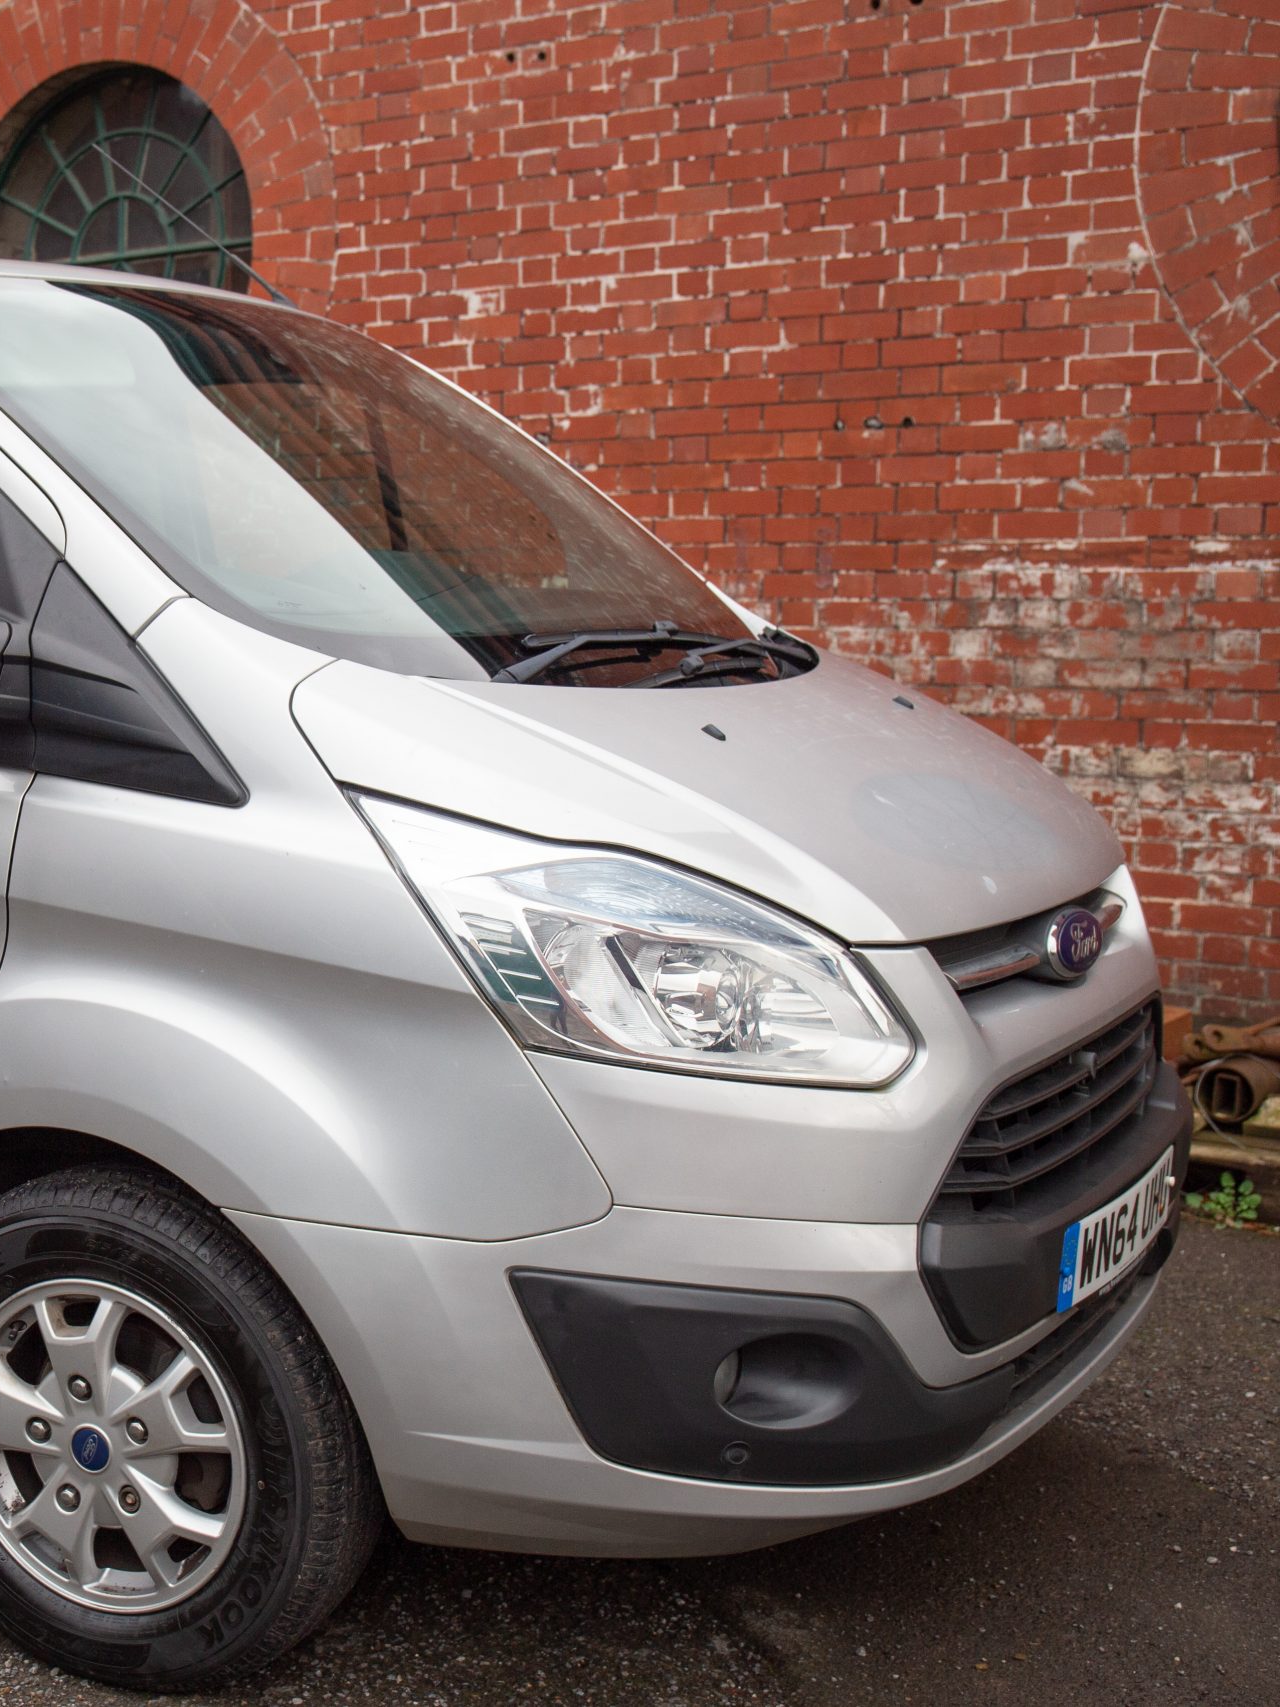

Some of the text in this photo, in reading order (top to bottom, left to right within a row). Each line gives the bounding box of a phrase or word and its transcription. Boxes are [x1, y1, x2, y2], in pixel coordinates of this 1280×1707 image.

[1069, 920, 1099, 962] Ford
[1080, 1192, 1139, 1289] WN64
[1062, 1275, 1073, 1294] GB
